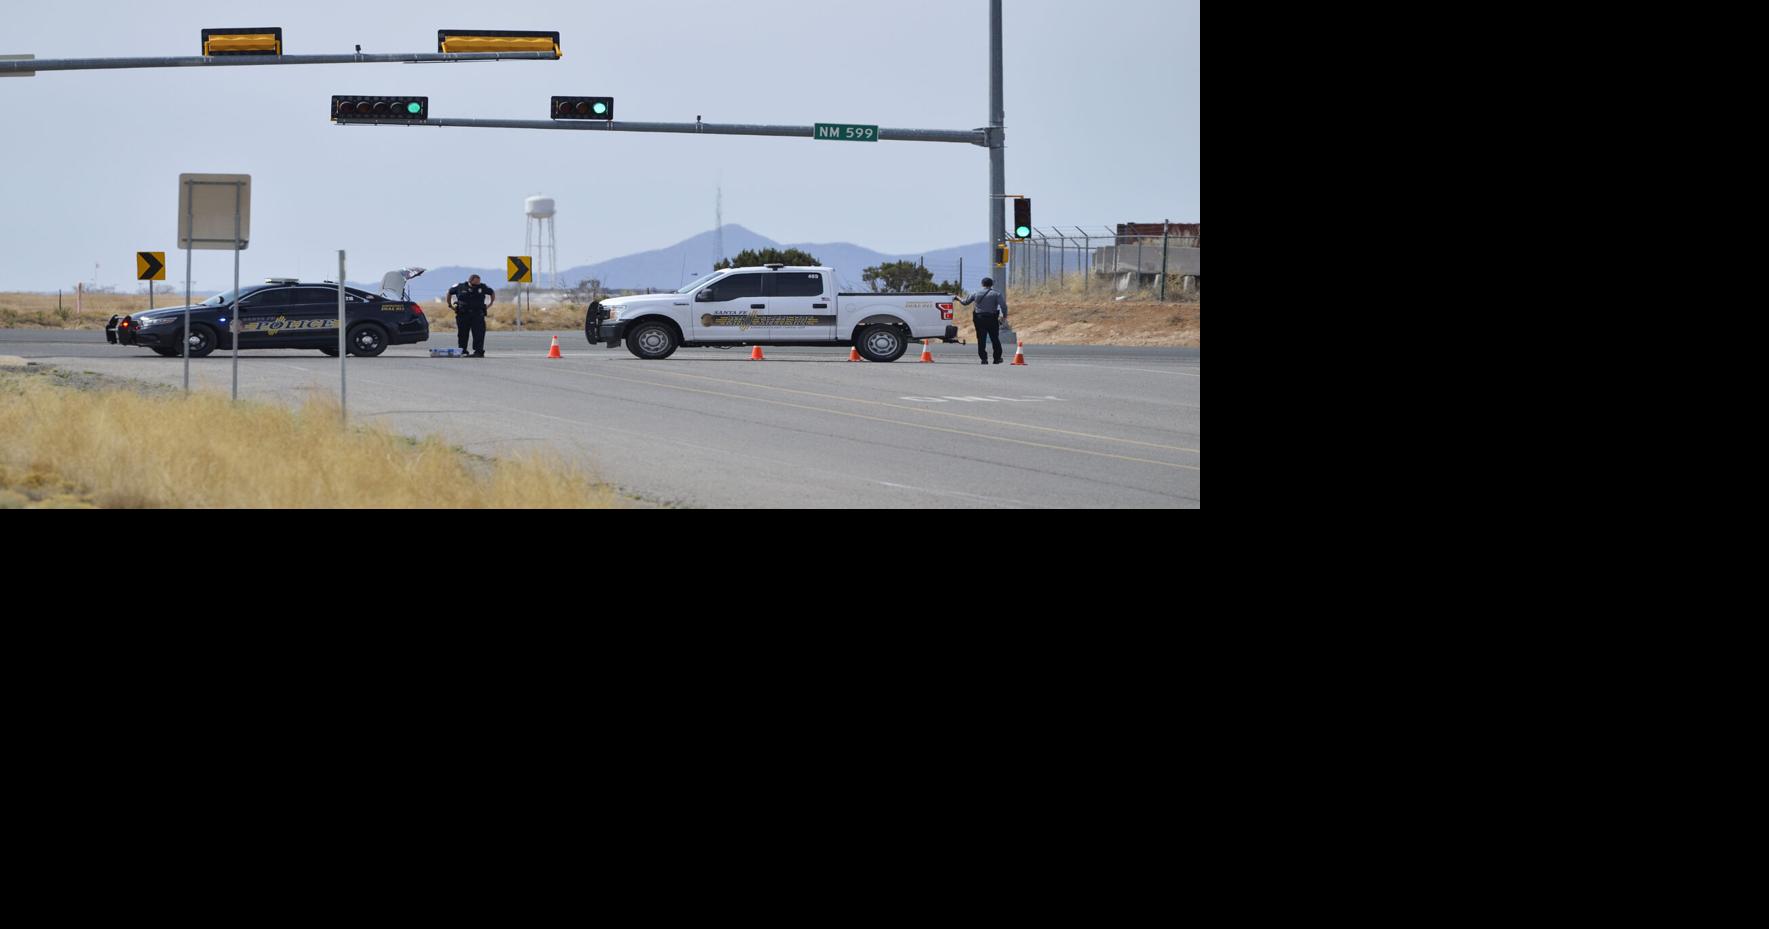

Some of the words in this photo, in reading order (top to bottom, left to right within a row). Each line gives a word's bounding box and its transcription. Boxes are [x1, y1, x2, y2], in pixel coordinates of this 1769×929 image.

[819, 126, 840, 138] NM
[846, 127, 873, 139] 599
[256, 319, 337, 330] POLICE
